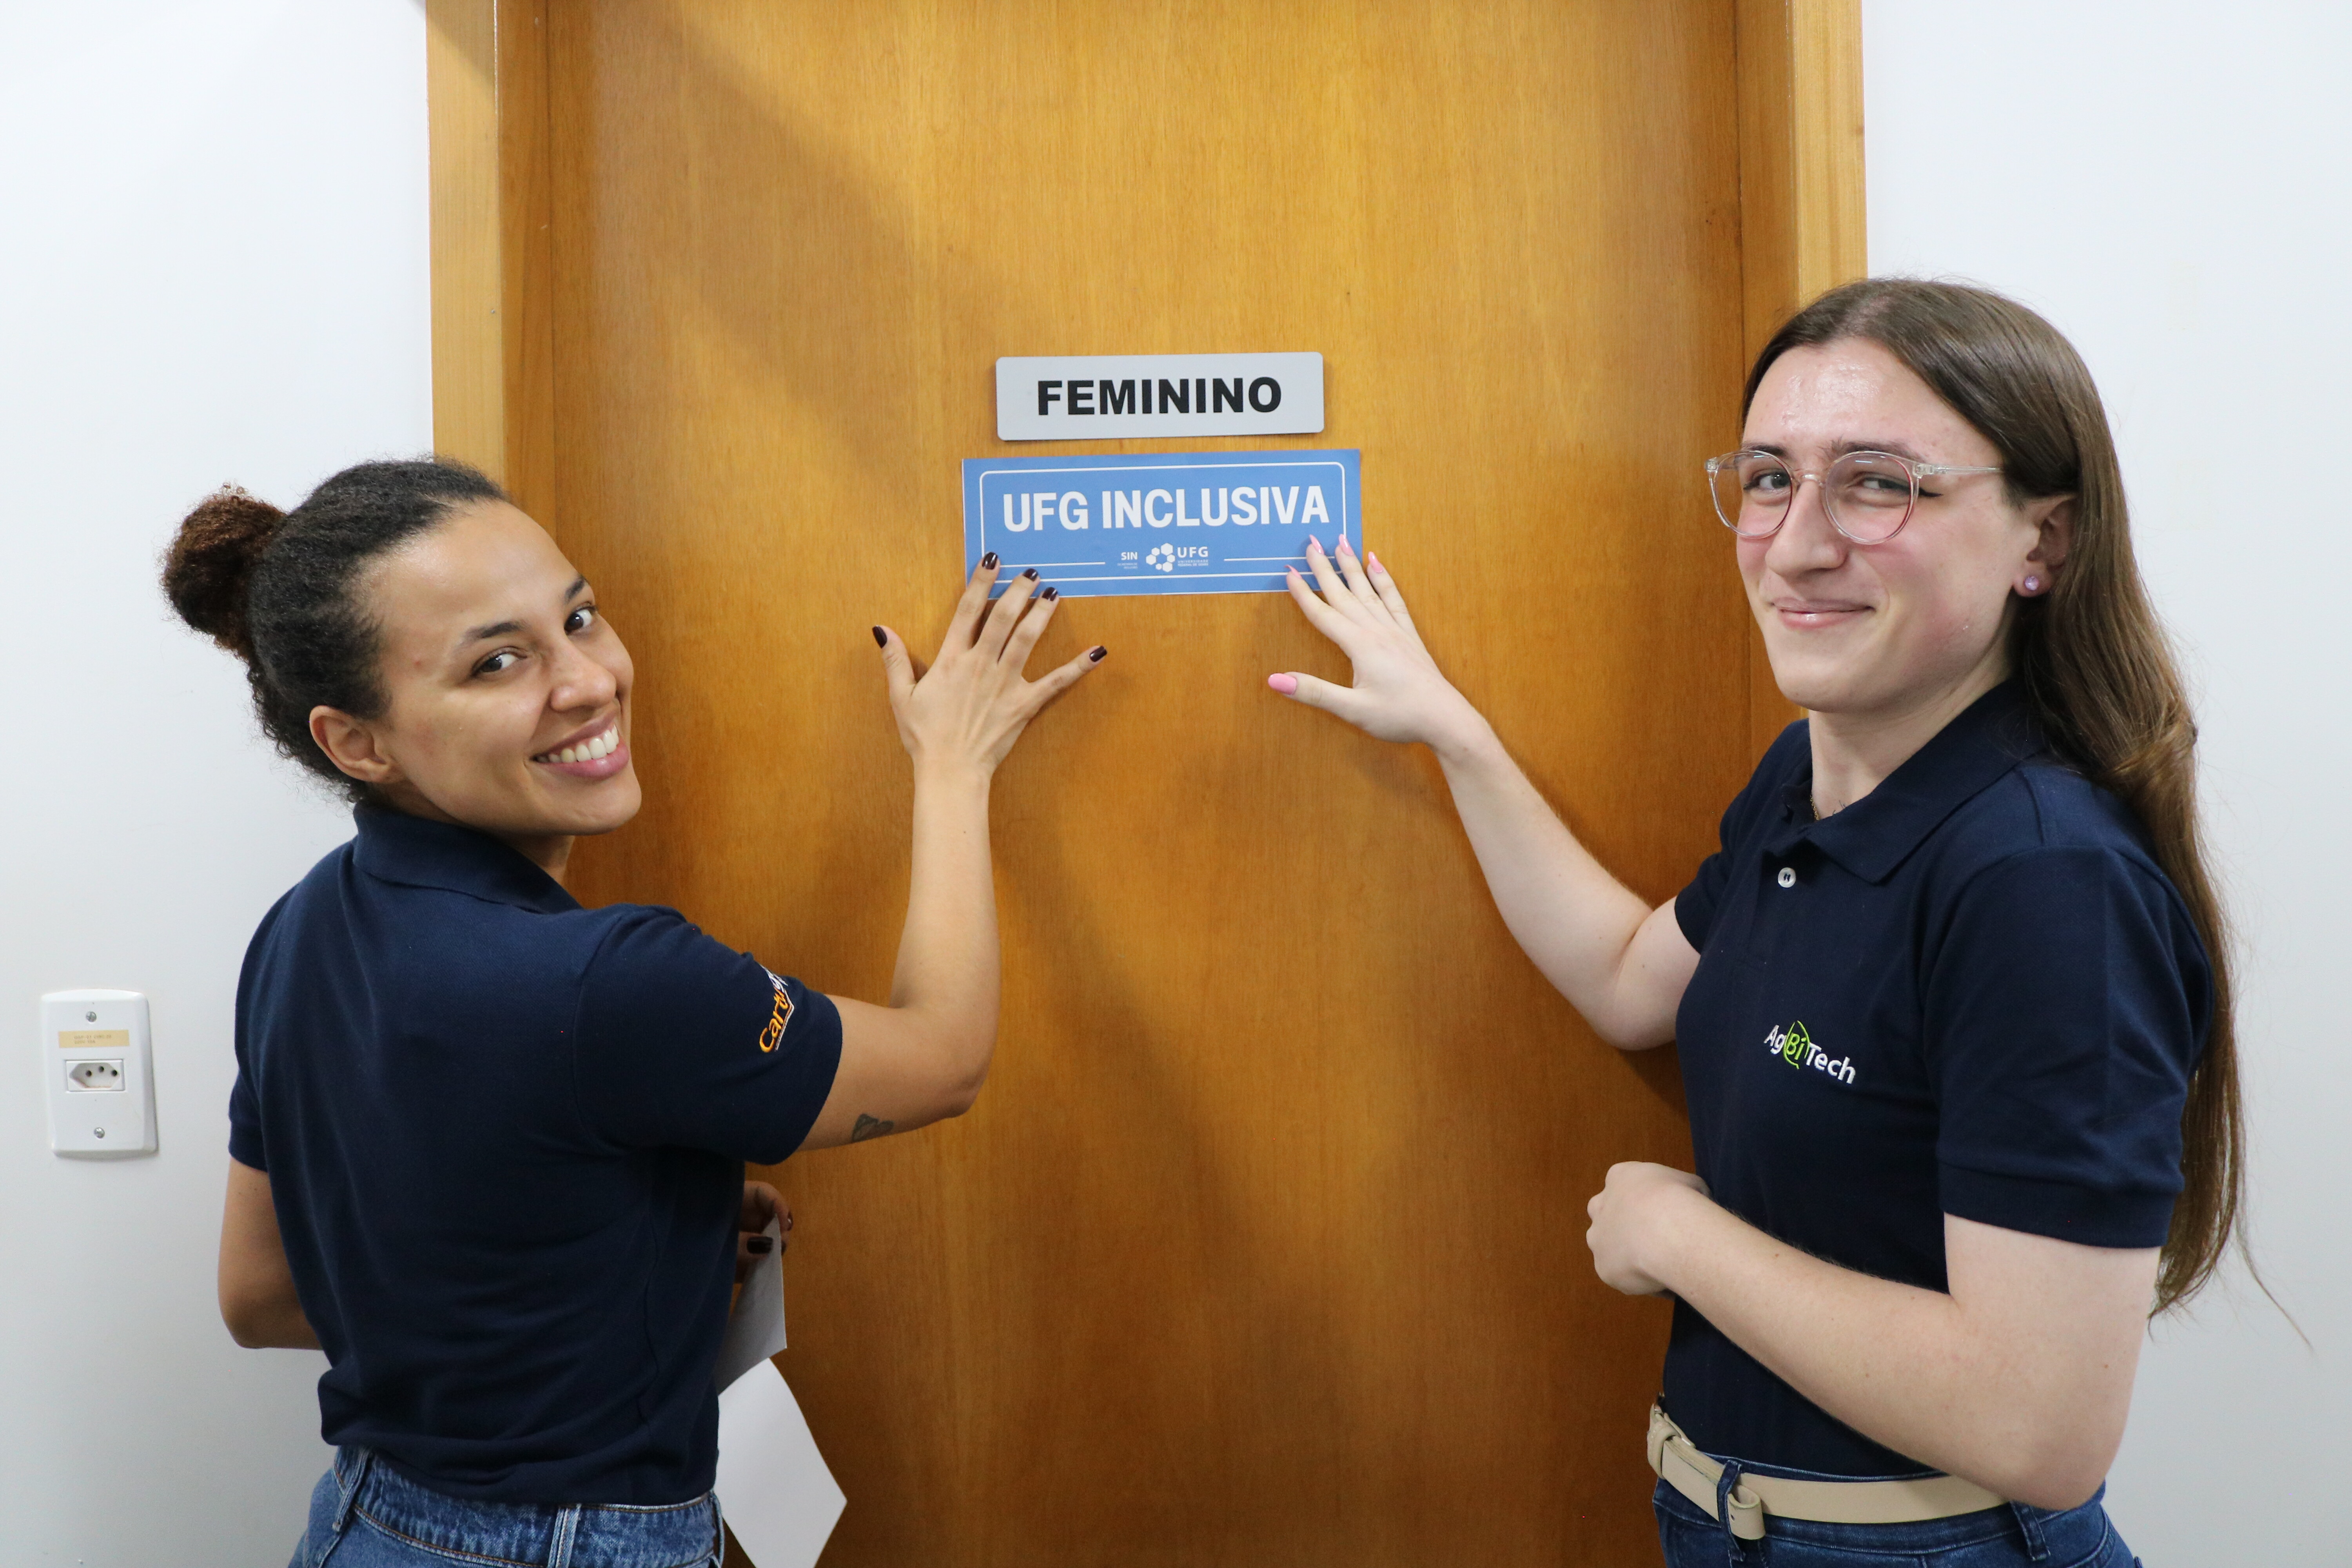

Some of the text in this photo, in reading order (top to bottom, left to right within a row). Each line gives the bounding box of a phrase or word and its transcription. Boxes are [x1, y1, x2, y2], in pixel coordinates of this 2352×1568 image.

[1038, 377, 1281, 416] FEMININO
[1003, 485, 1330, 532] UFG INCLUSIVA
[1121, 552, 1138, 561] SIN
[1177, 546, 1209, 558] UFG
[1763, 1024, 1856, 1084] AgBiTech
